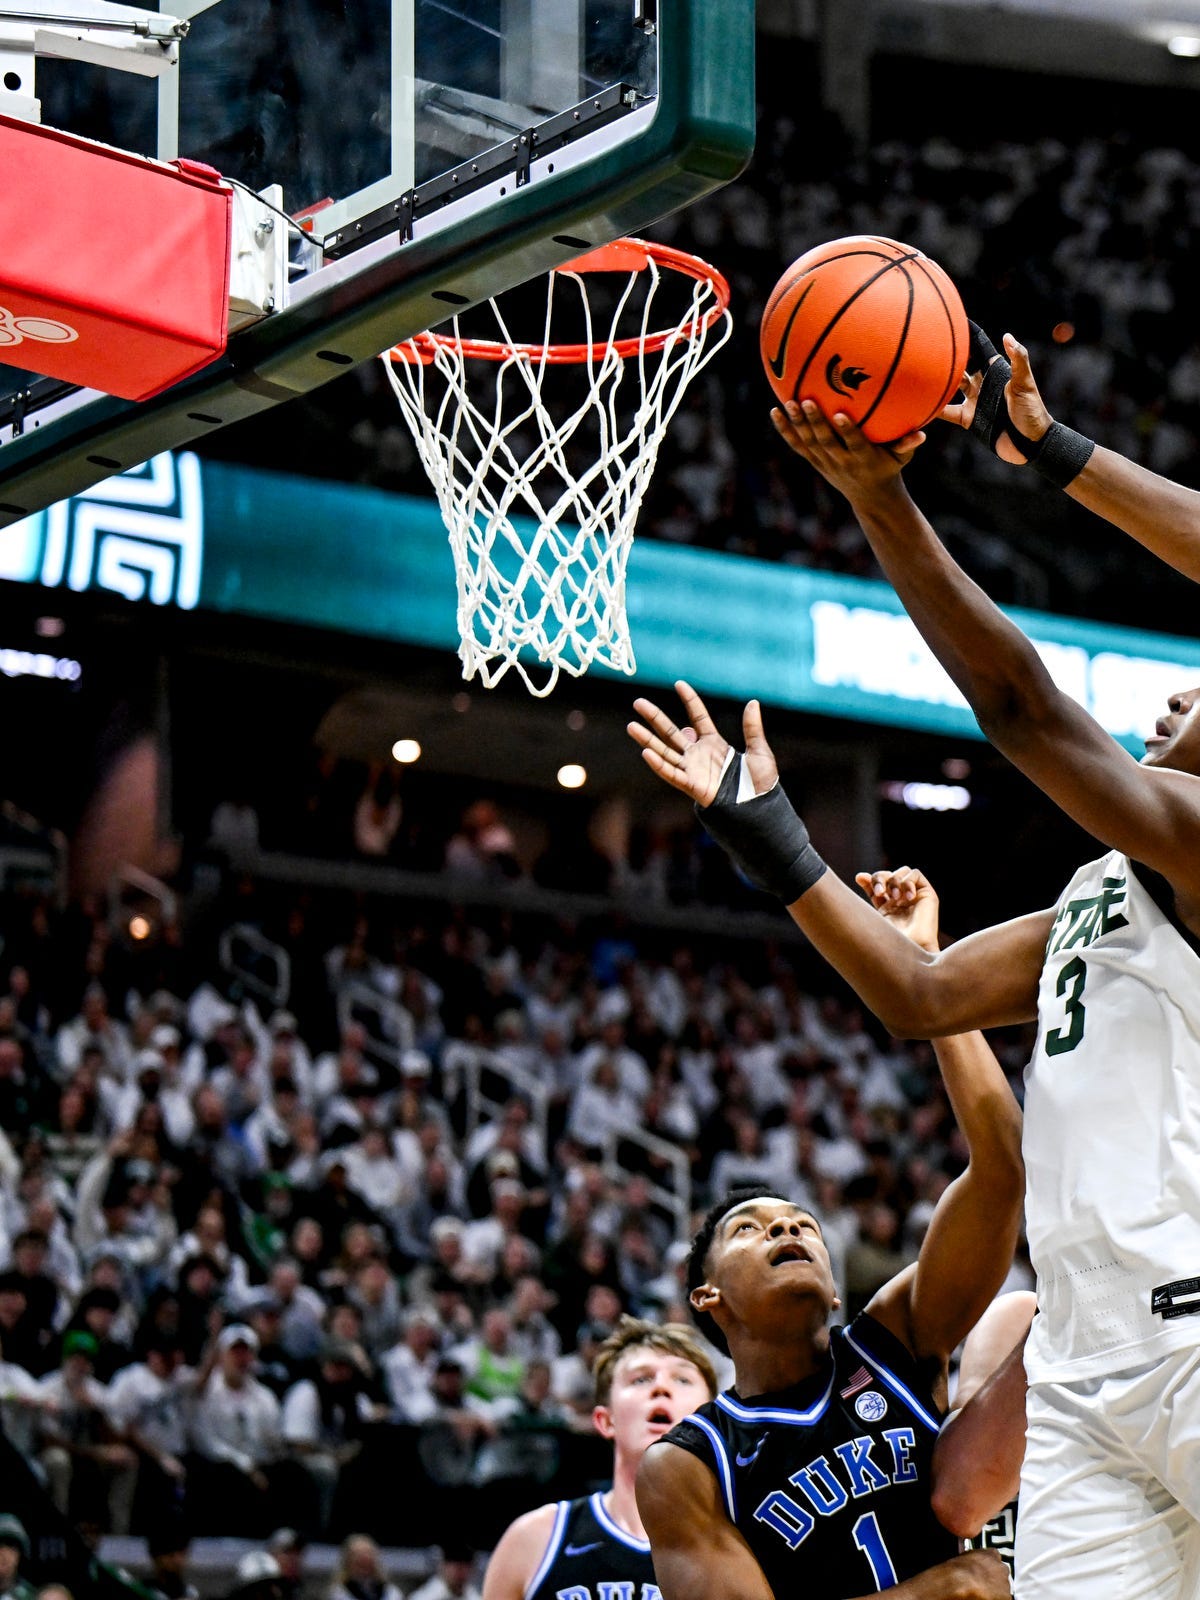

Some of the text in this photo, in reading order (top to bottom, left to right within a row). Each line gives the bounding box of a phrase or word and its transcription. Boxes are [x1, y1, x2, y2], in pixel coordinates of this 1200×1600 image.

[1045, 877, 1129, 963] STAE
[1045, 955, 1087, 1057] 3
[753, 1427, 918, 1551] DUKE
[852, 1511, 899, 1592] 1
